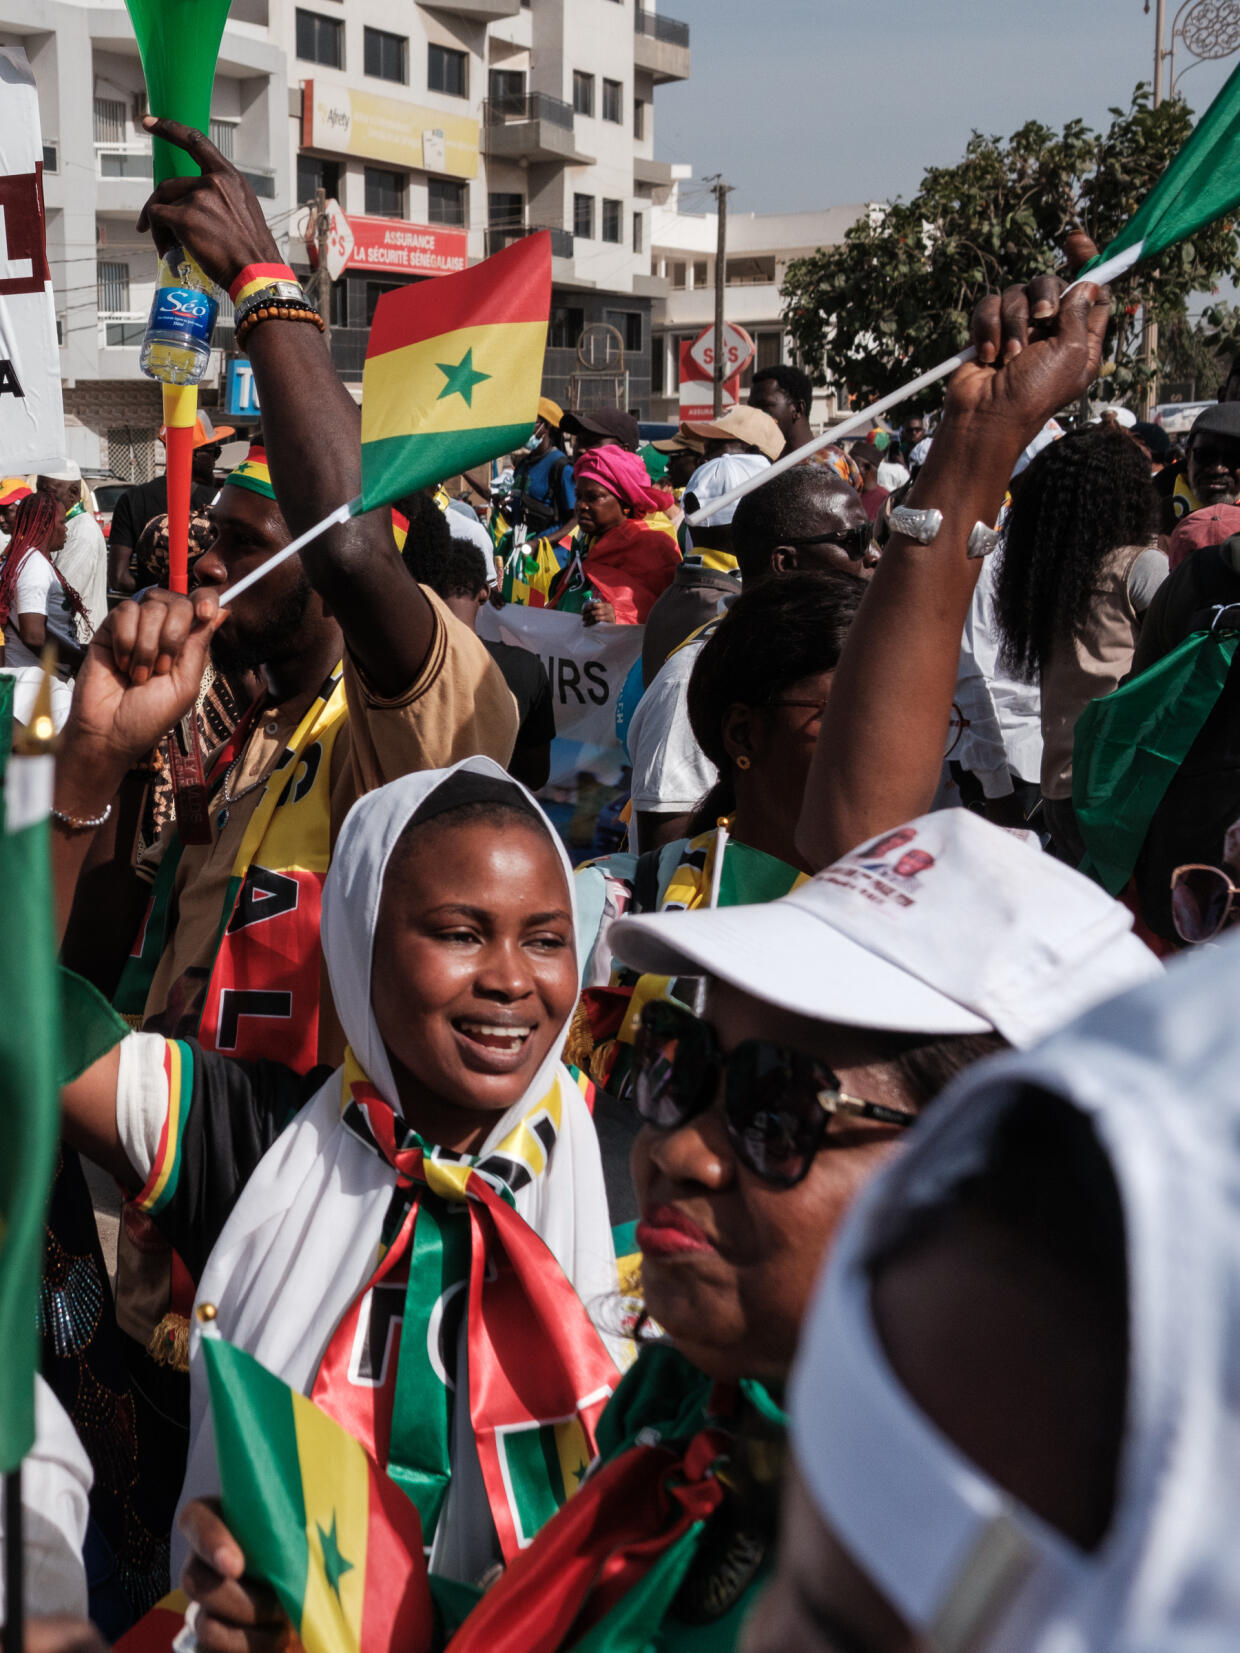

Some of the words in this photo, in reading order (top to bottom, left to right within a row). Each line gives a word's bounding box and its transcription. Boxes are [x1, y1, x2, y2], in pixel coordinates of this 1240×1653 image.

[384, 230, 435, 249] ASSURANCE
[354, 246, 366, 261] LA
[368, 245, 408, 265] SÉCURITÉ
[410, 250, 464, 270] SÉNÉGALAISE
[160, 291, 206, 316] Séo
